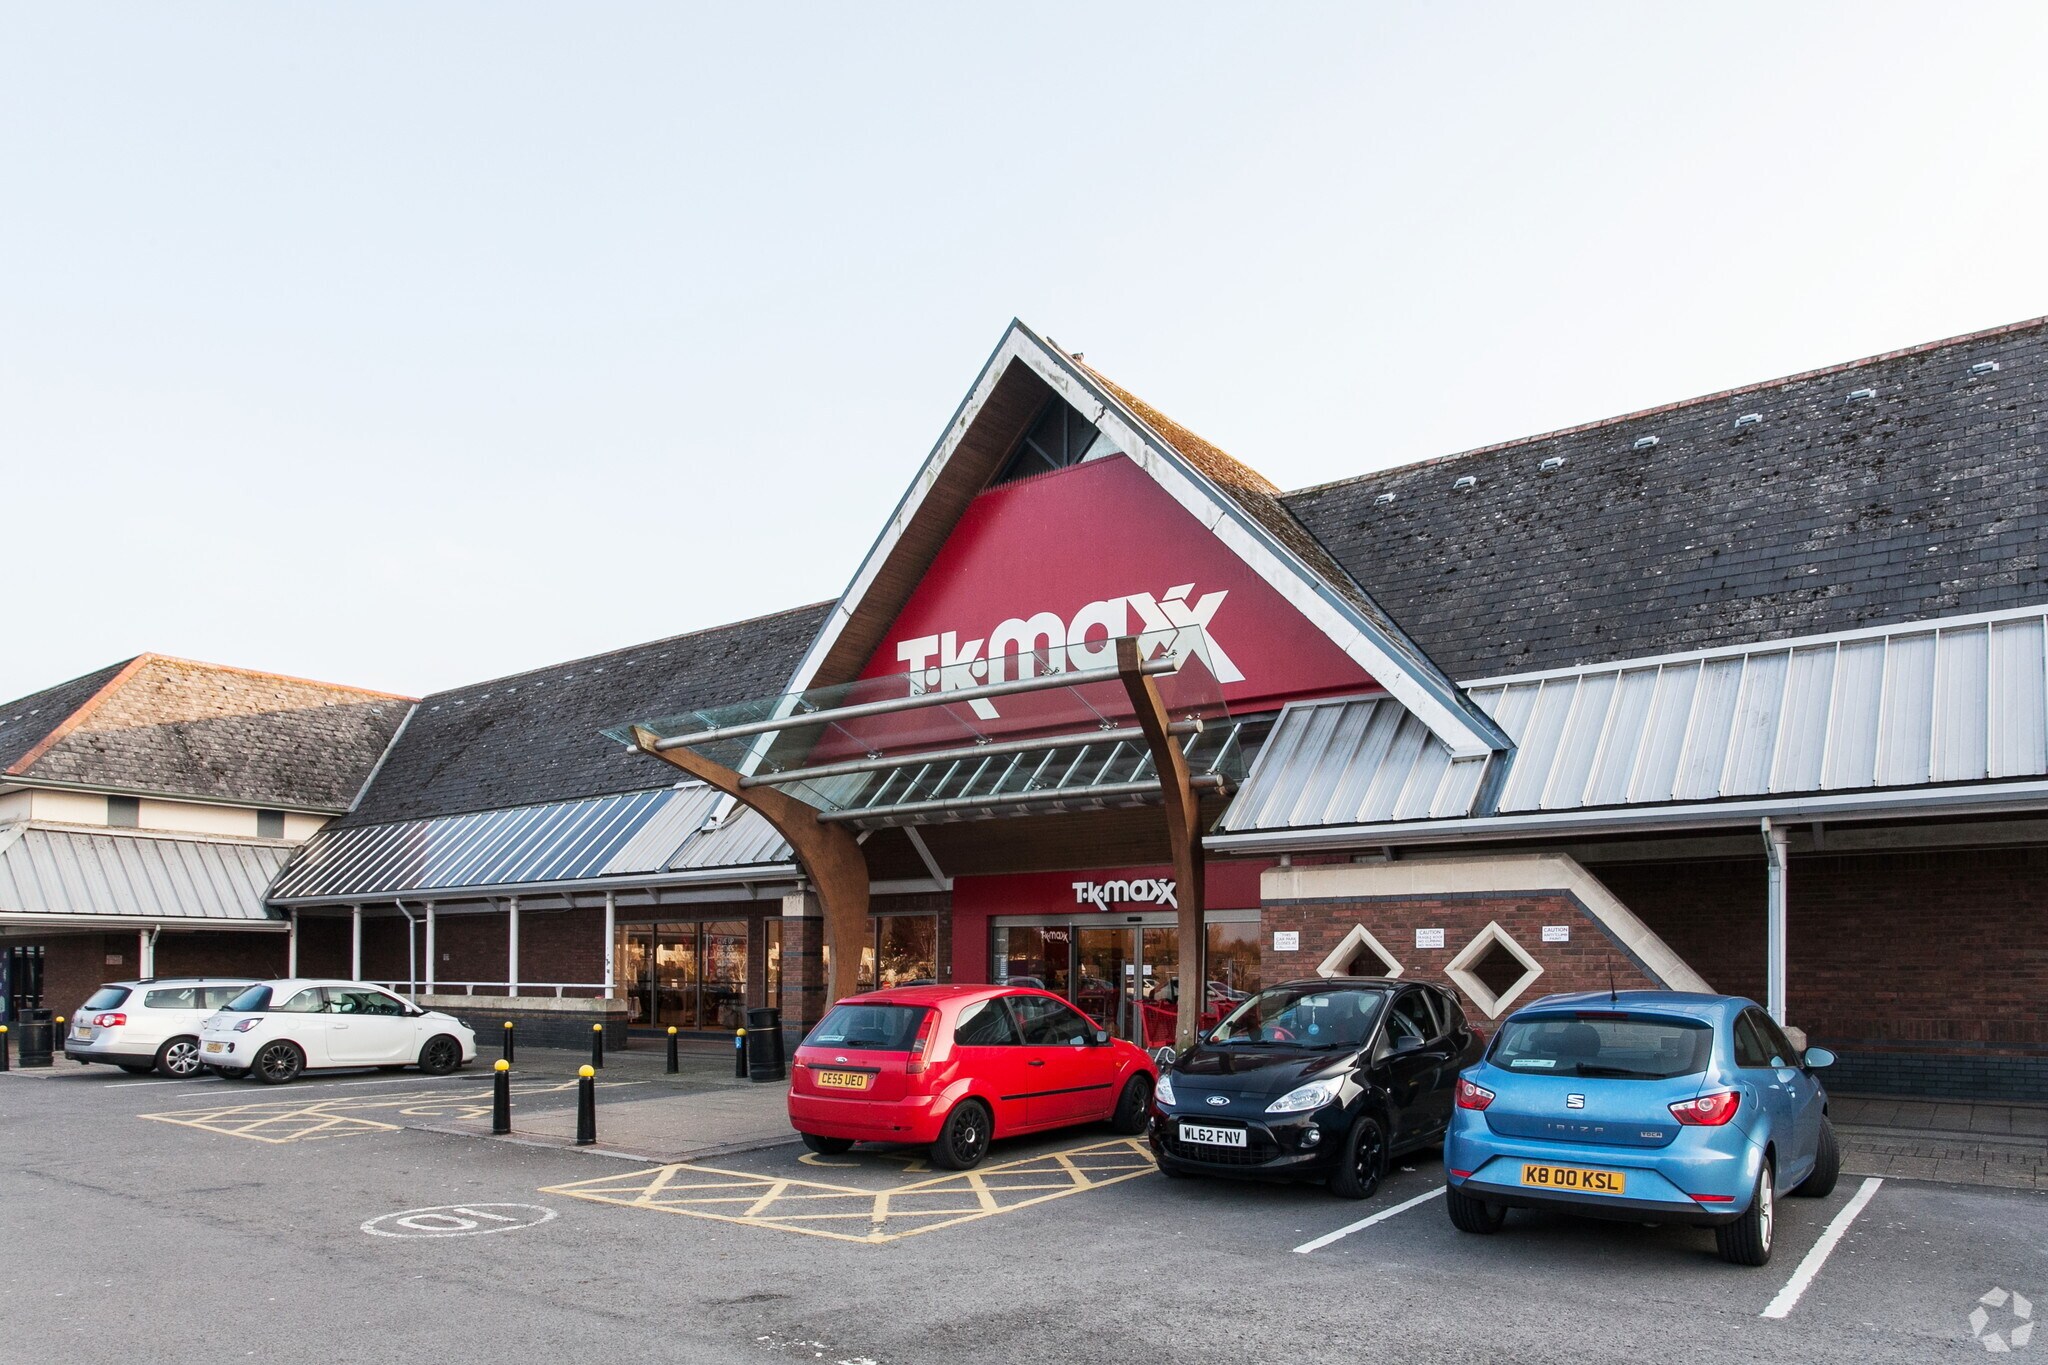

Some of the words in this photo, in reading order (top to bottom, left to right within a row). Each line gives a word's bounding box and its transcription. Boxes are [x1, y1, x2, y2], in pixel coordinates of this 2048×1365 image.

[821, 1072, 844, 1085] CE55
[844, 1074, 864, 1086] UEO
[1184, 1126, 1213, 1142] WL62
[1216, 1130, 1241, 1144] FNV
[1547, 1123, 1604, 1133] IBIZA
[1582, 1171, 1618, 1190] KSL
